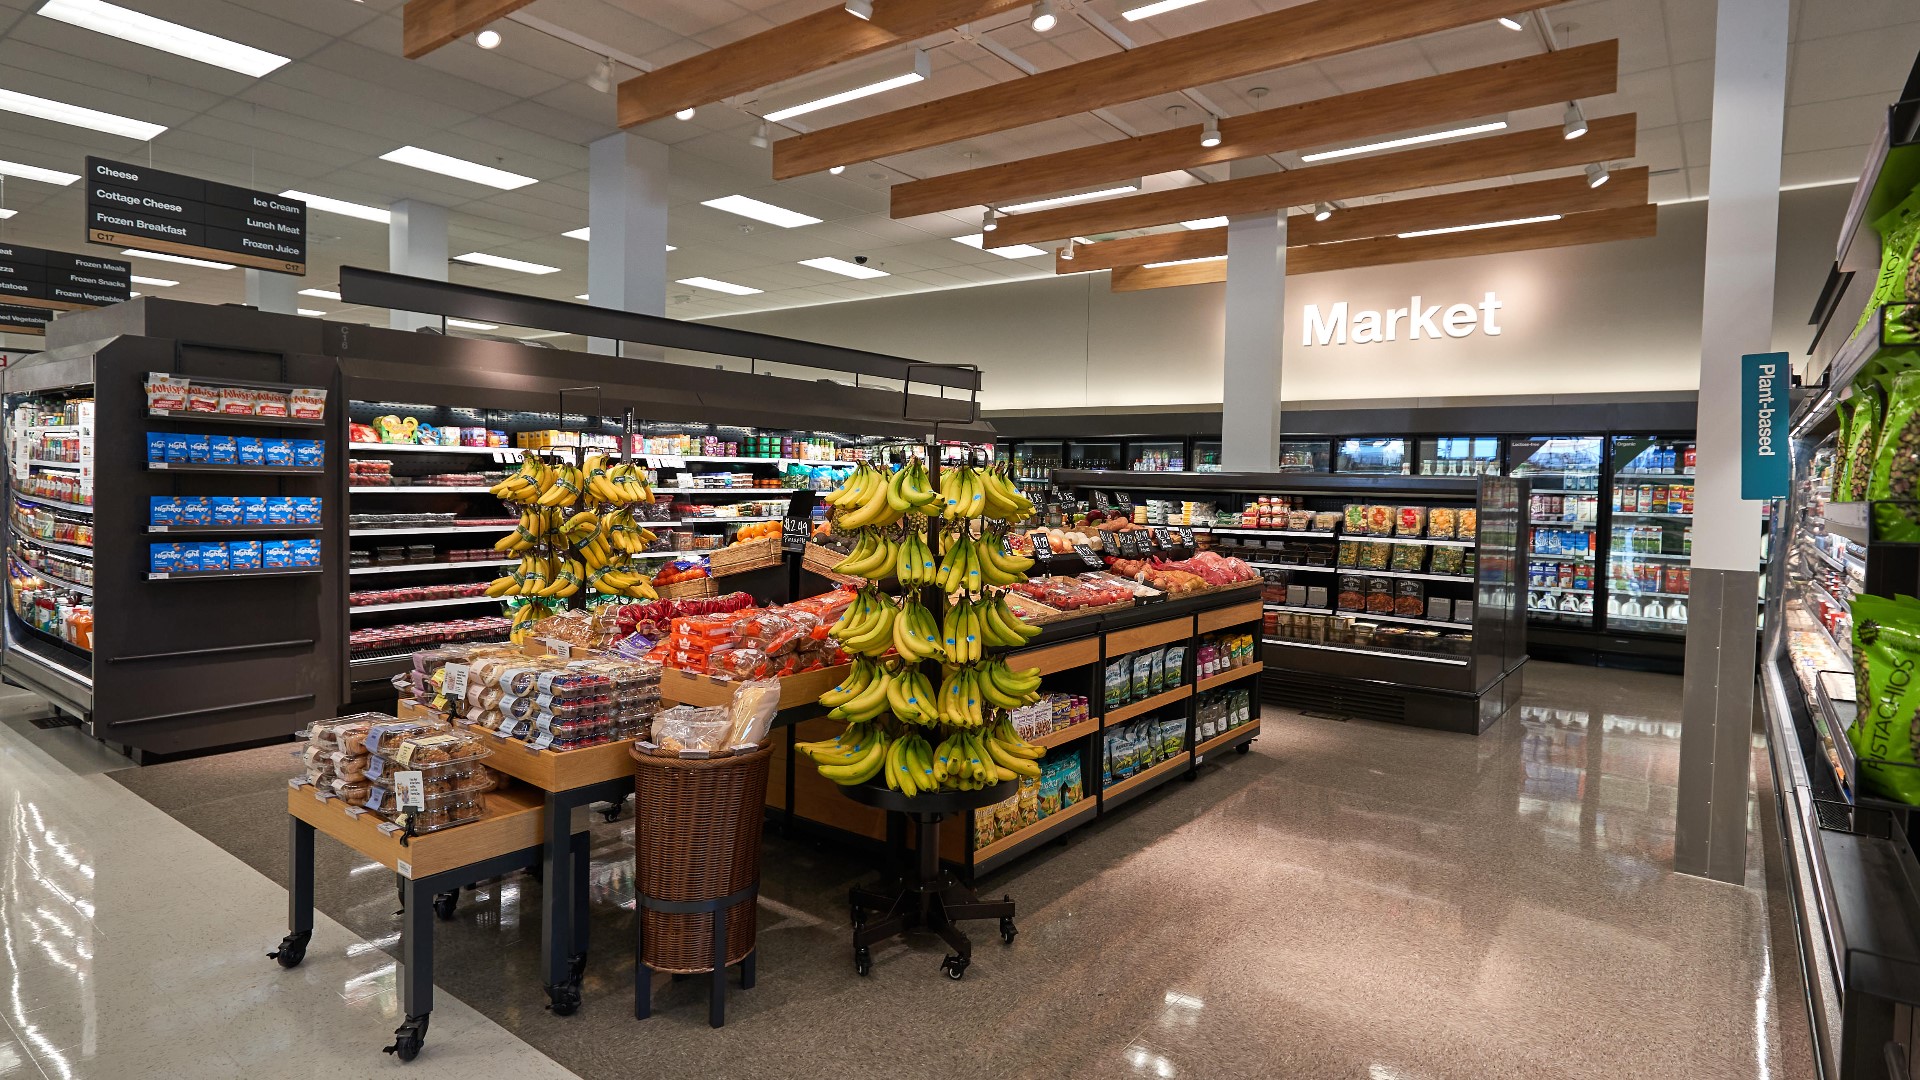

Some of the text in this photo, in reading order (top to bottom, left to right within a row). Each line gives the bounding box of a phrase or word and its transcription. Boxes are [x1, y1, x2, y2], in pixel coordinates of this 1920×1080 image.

[96, 165, 139, 182] Cheese
[96, 188, 183, 213] Cottage Cheese
[253, 197, 300, 214] Ice Cream
[96, 212, 187, 237] Frozen Breakfast
[246, 217, 300, 235] Lunch Meat
[97, 231, 115, 242] C17
[242, 238, 300, 255] Frozen Juice
[75, 259, 126, 272] Frozen Meals
[285, 263, 300, 271] C17
[70, 274, 126, 288] Frozen Snacks
[55, 289, 82, 298] Frozen
[1302, 291, 1503, 346] Market
[1758, 364, 1776, 456] Plant-based
[784, 517, 808, 536] $2.49
[1867, 657, 1915, 772] PISTACHIOS
